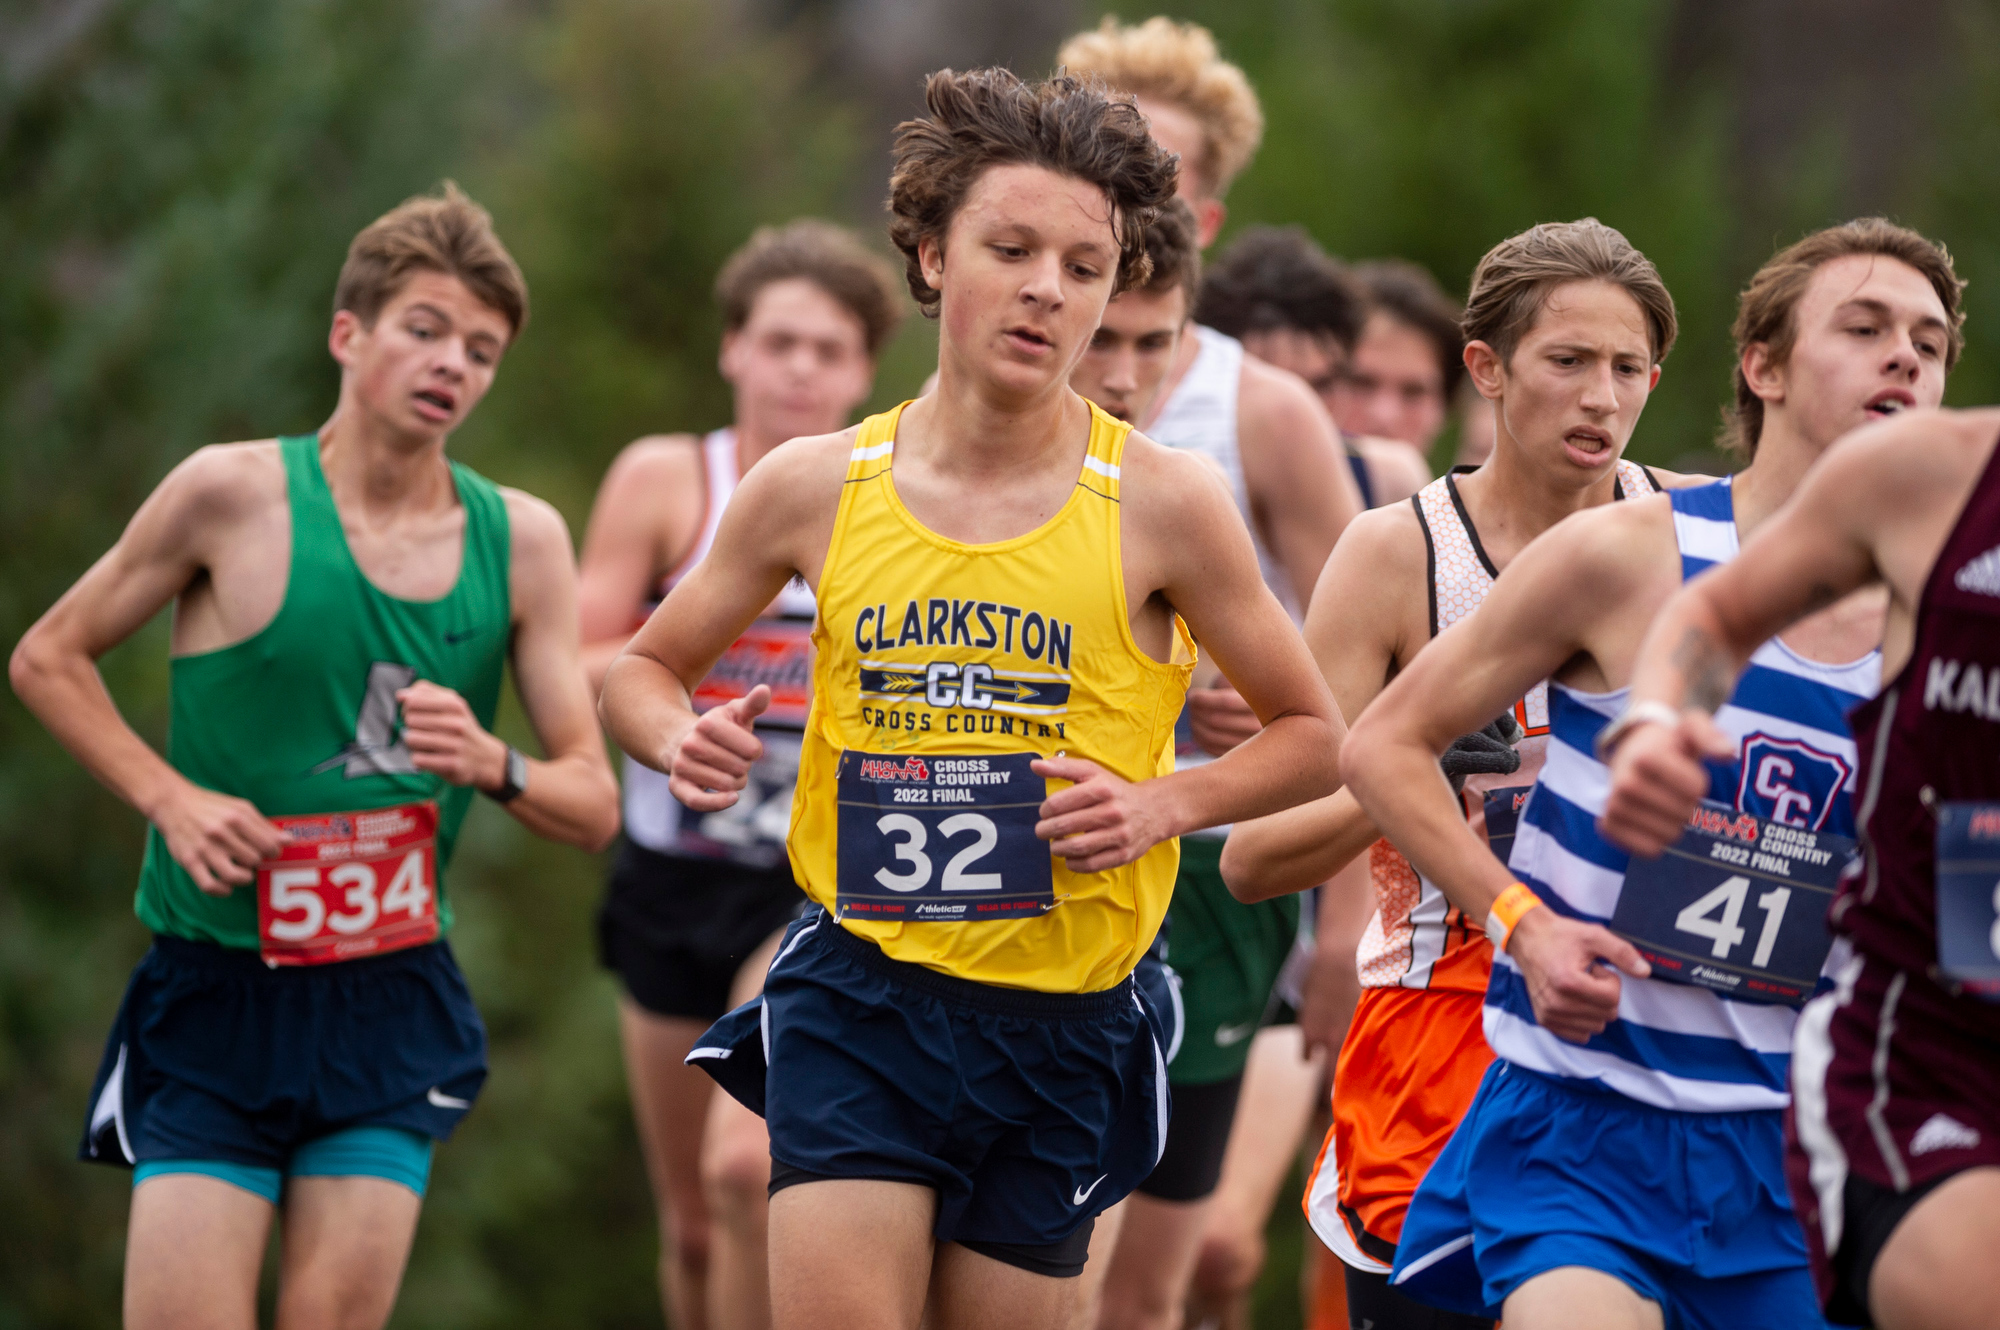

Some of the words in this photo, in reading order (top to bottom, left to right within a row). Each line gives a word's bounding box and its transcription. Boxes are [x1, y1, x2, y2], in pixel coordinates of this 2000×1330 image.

[855, 598, 1072, 670] CLARKSTON
[925, 661, 994, 710] CC
[862, 707, 931, 731] CROSS
[946, 714, 1065, 739] COUNTRY
[860, 758, 920, 780] MHSAA
[934, 759, 989, 773] CROSS
[935, 771, 1011, 785] COUNTRY
[893, 788, 928, 803] 2022
[932, 787, 975, 803] FINAL
[1760, 837, 1832, 866] COUNTRY
[1764, 824, 1817, 848] CROSS
[873, 813, 1003, 892] 32
[1710, 842, 1750, 866] 2022
[1751, 851, 1791, 877] FINAL
[268, 849, 432, 942] 534
[1674, 875, 1792, 968] 41
